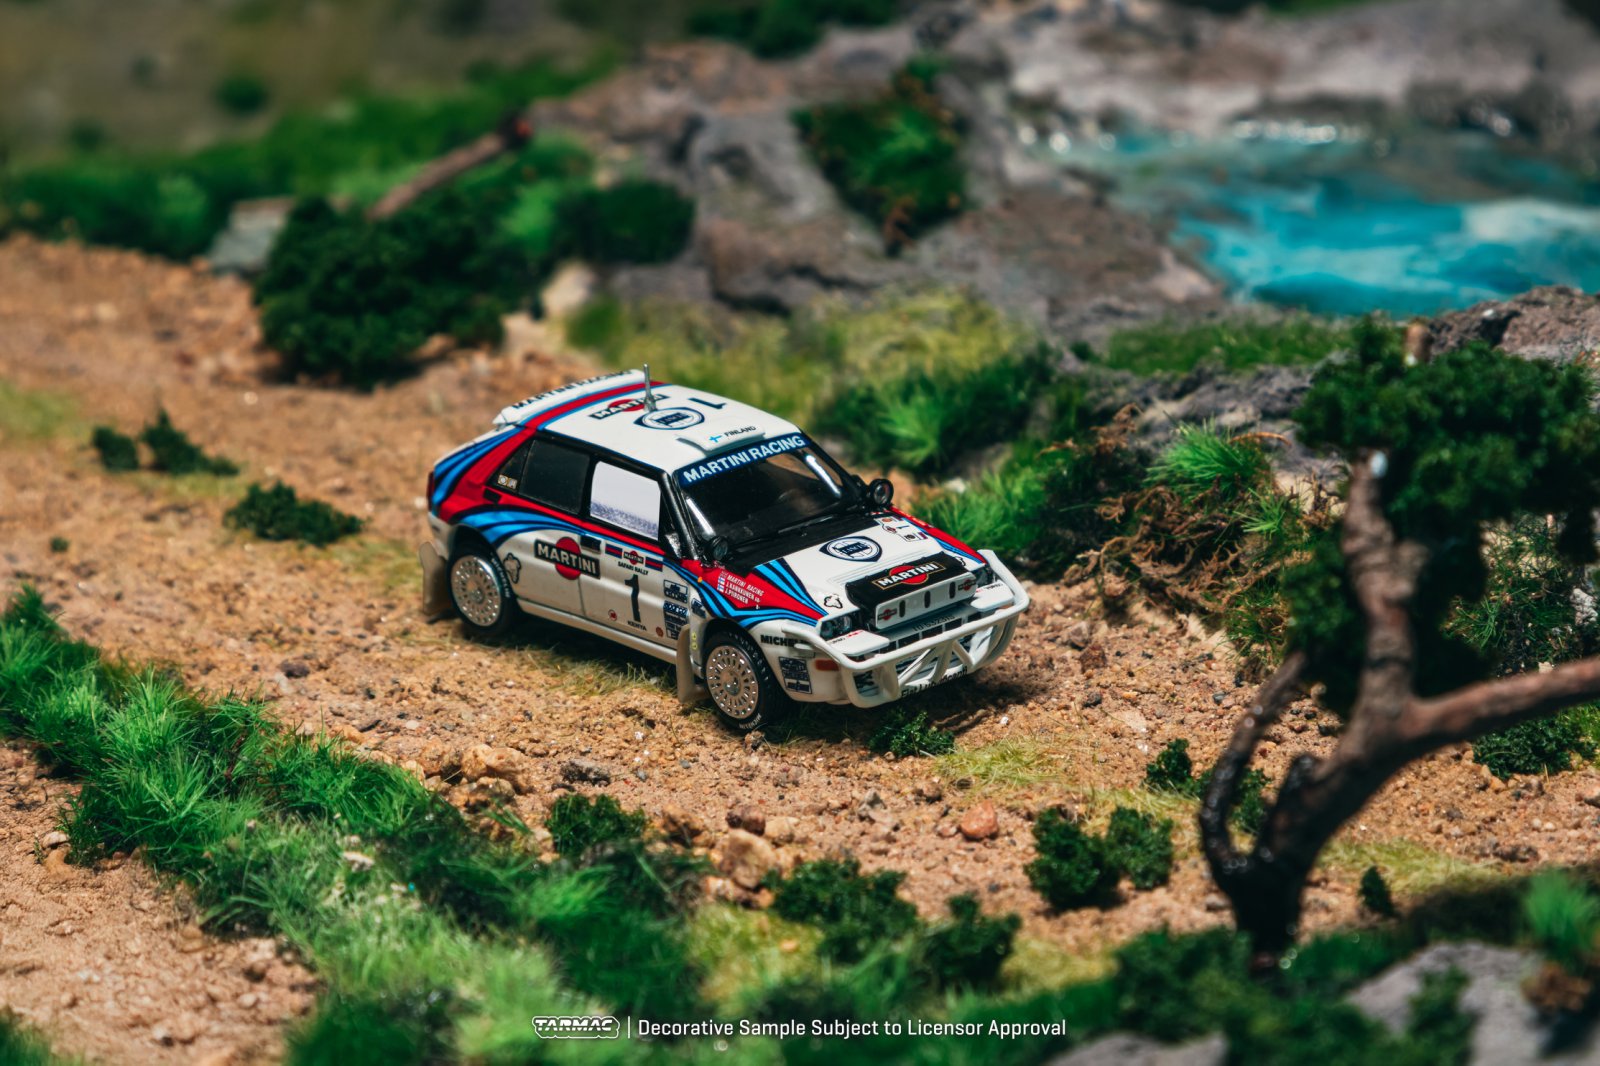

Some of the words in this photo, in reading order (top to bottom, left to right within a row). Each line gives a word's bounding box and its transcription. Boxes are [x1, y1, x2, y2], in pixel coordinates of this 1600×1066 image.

[724, 425, 757, 437] FINLAND
[683, 451, 750, 483] MARTINI
[748, 435, 806, 460] RACING
[537, 543, 596, 574] MARTINI
[878, 562, 939, 587] MARTINI
[624, 573, 641, 623] 1
